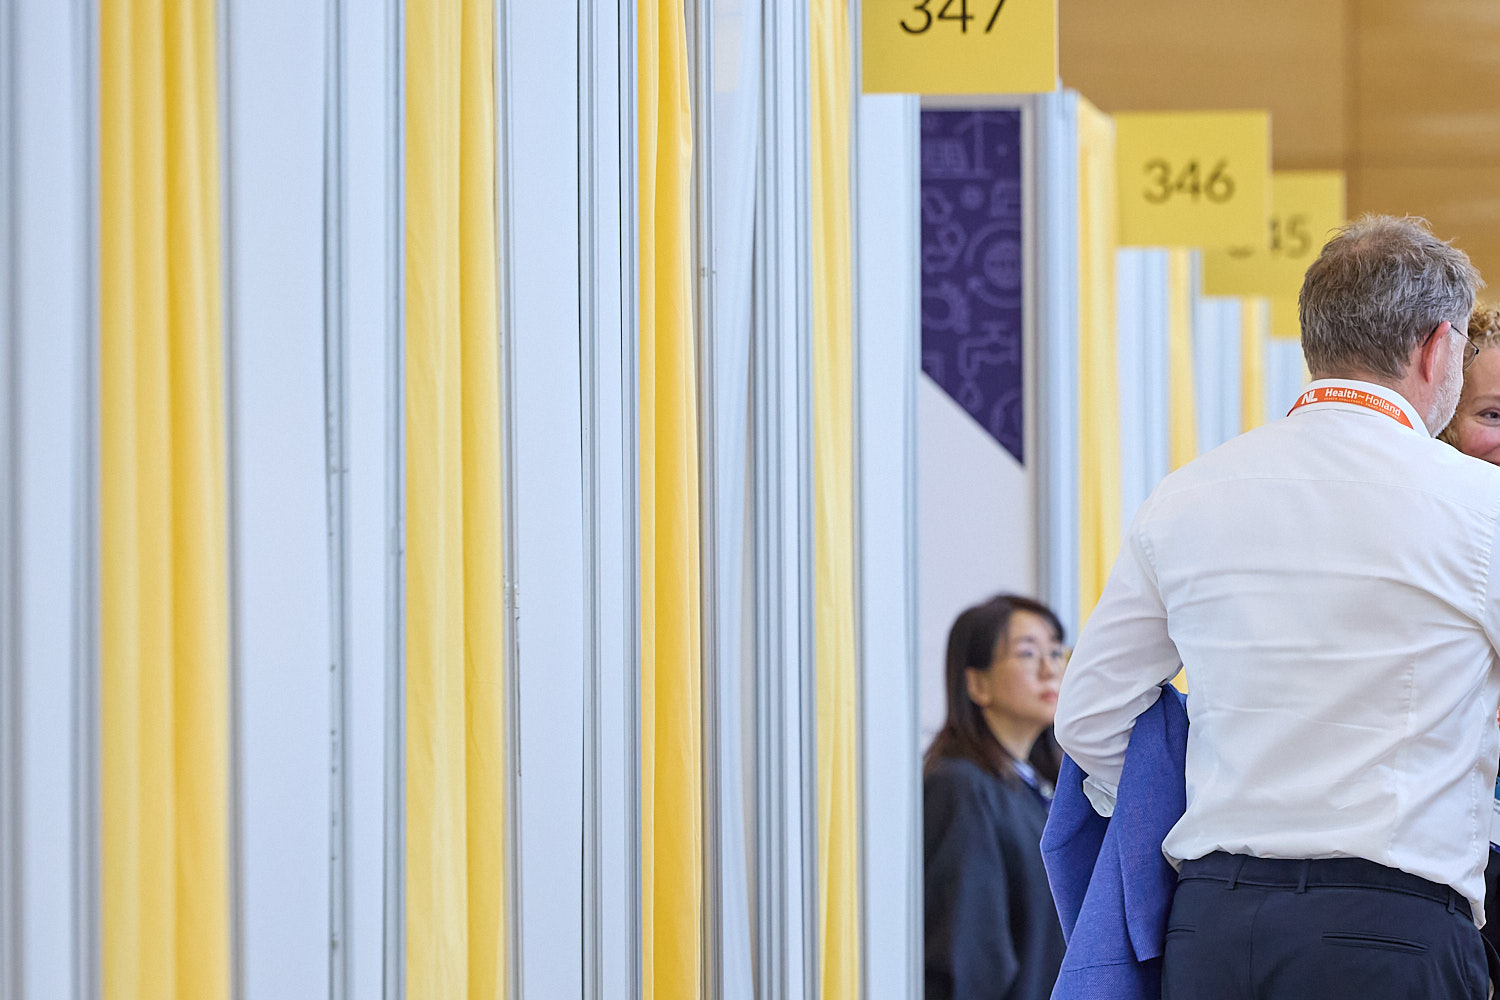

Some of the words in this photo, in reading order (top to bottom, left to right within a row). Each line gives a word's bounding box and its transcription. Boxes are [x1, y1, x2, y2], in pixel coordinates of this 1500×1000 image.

[899, 0, 1007, 34] 347
[1142, 157, 1236, 205] 346
[1301, 390, 1318, 405] NL
